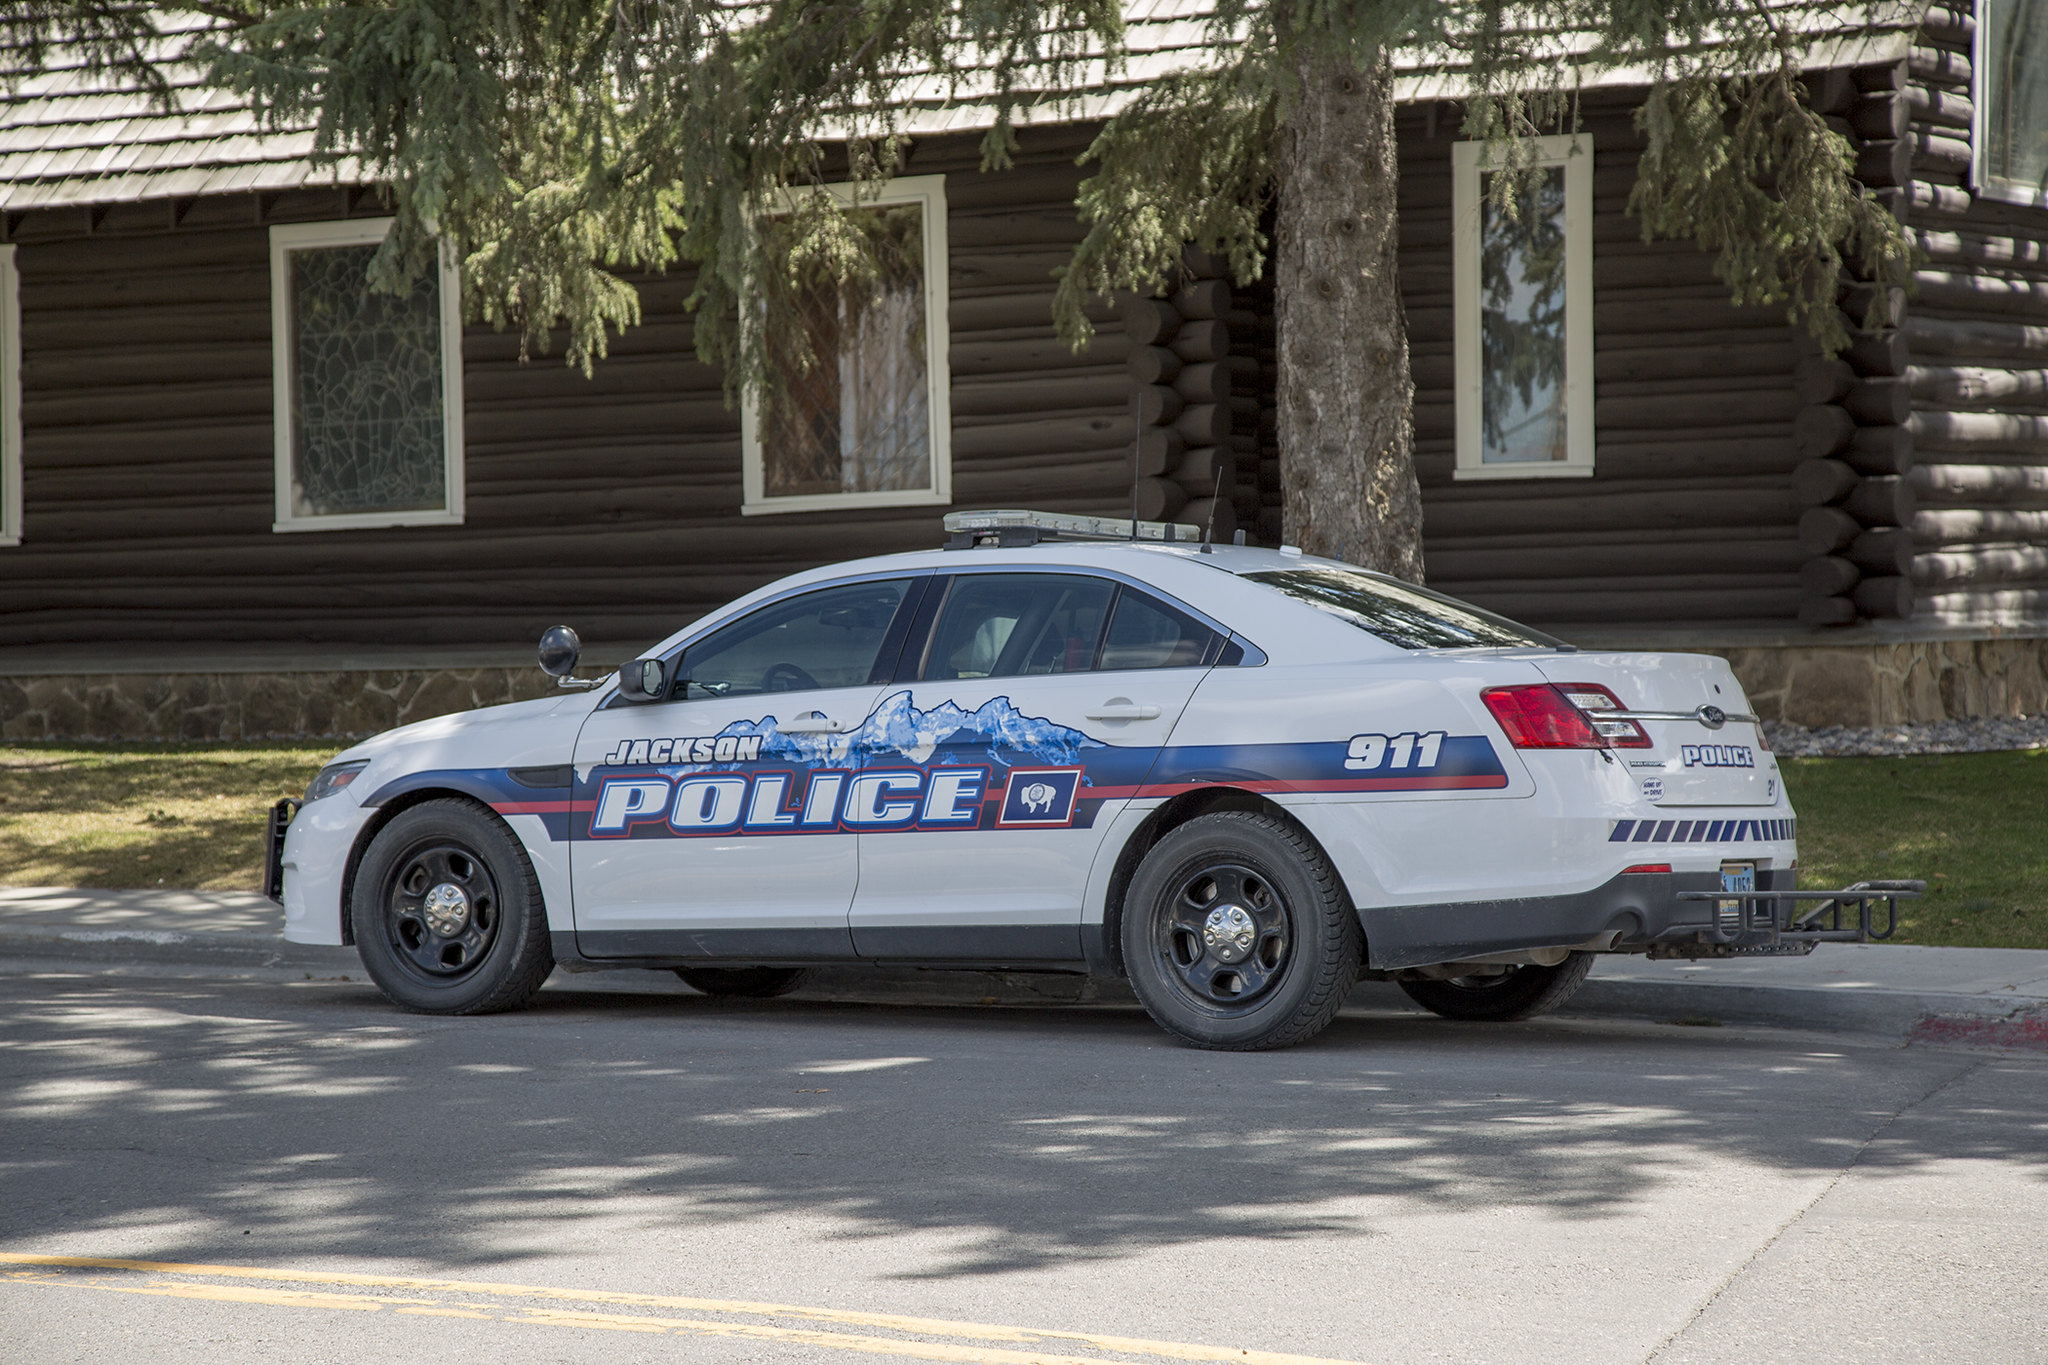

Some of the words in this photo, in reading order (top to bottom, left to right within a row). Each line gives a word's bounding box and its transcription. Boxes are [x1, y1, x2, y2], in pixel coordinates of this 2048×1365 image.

[606, 735, 763, 764] JACKSON
[1344, 731, 1446, 770] 911
[1681, 745, 1755, 768] POLICE
[592, 771, 983, 832] POLICE
[1768, 779, 1776, 797] 21
